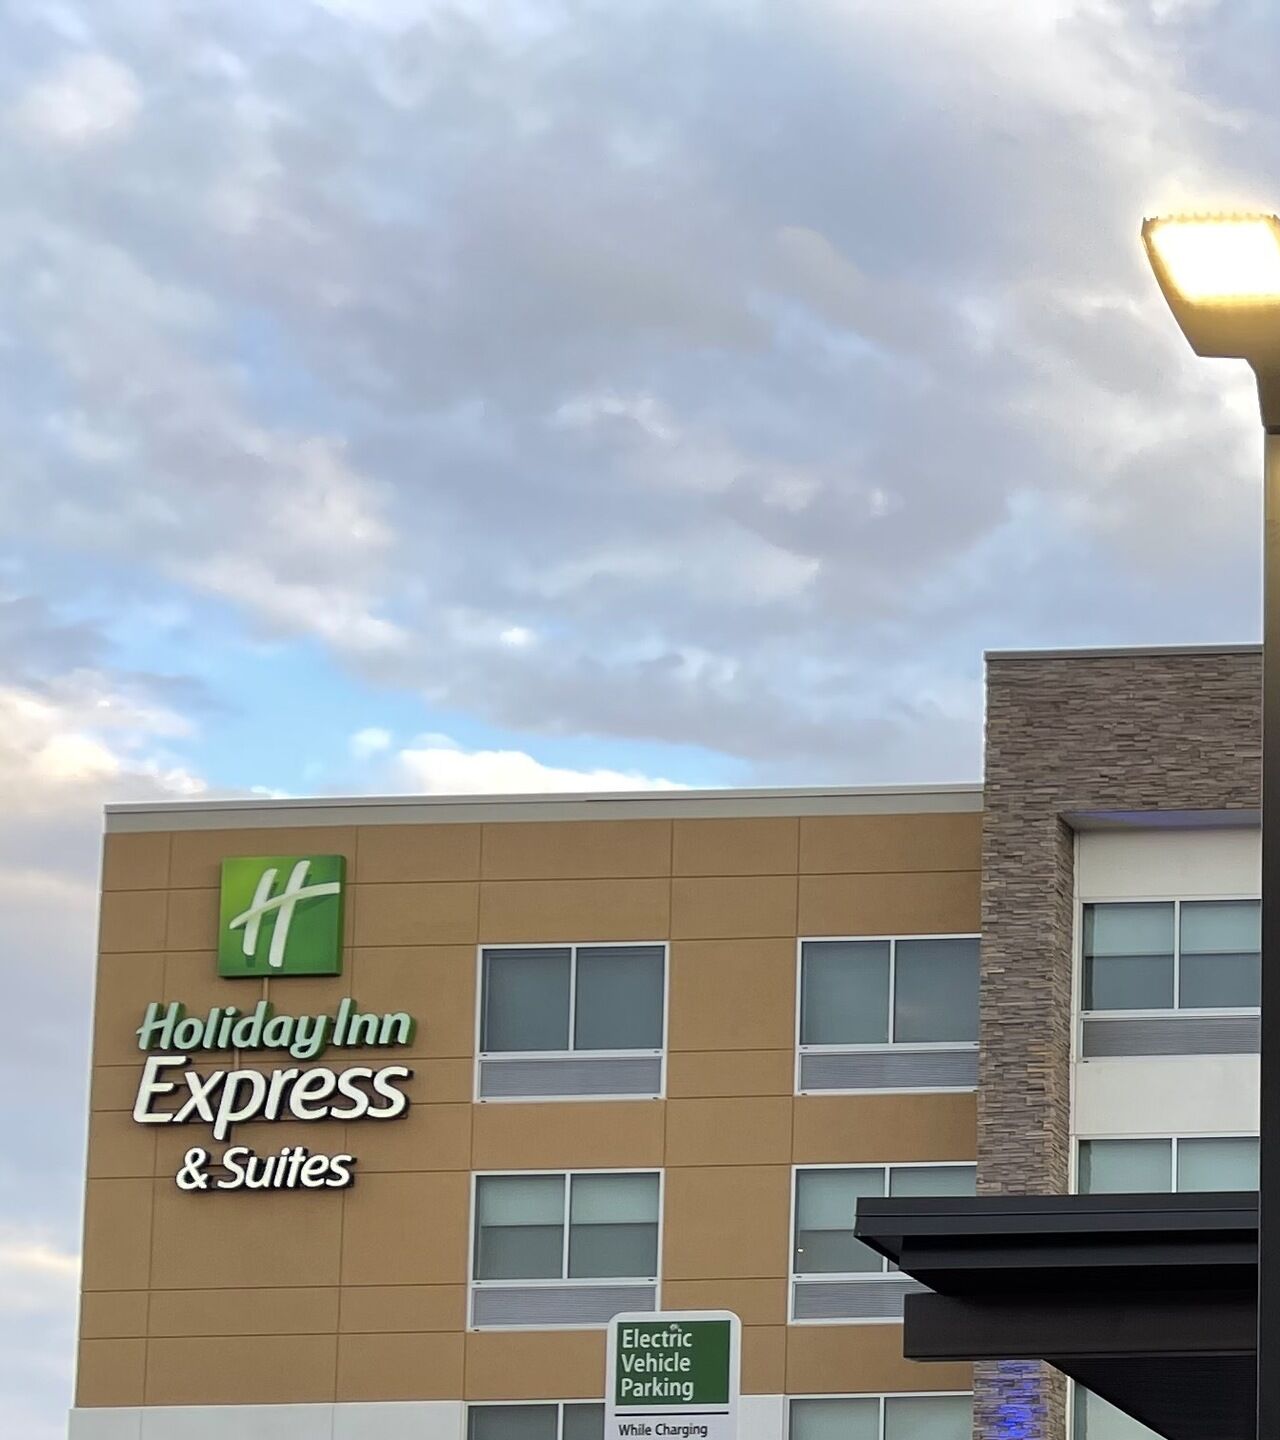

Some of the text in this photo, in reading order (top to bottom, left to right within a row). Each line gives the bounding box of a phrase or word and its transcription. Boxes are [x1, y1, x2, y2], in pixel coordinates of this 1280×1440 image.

[136, 998, 412, 1060] Holiday Inn
[133, 1055, 410, 1141] Express
[175, 1146, 354, 1190] & Suites
[622, 1328, 693, 1348] Electric
[621, 1352, 691, 1373] Vehicle
[621, 1377, 694, 1401] Parking
[618, 1423, 708, 1438] While Charging
